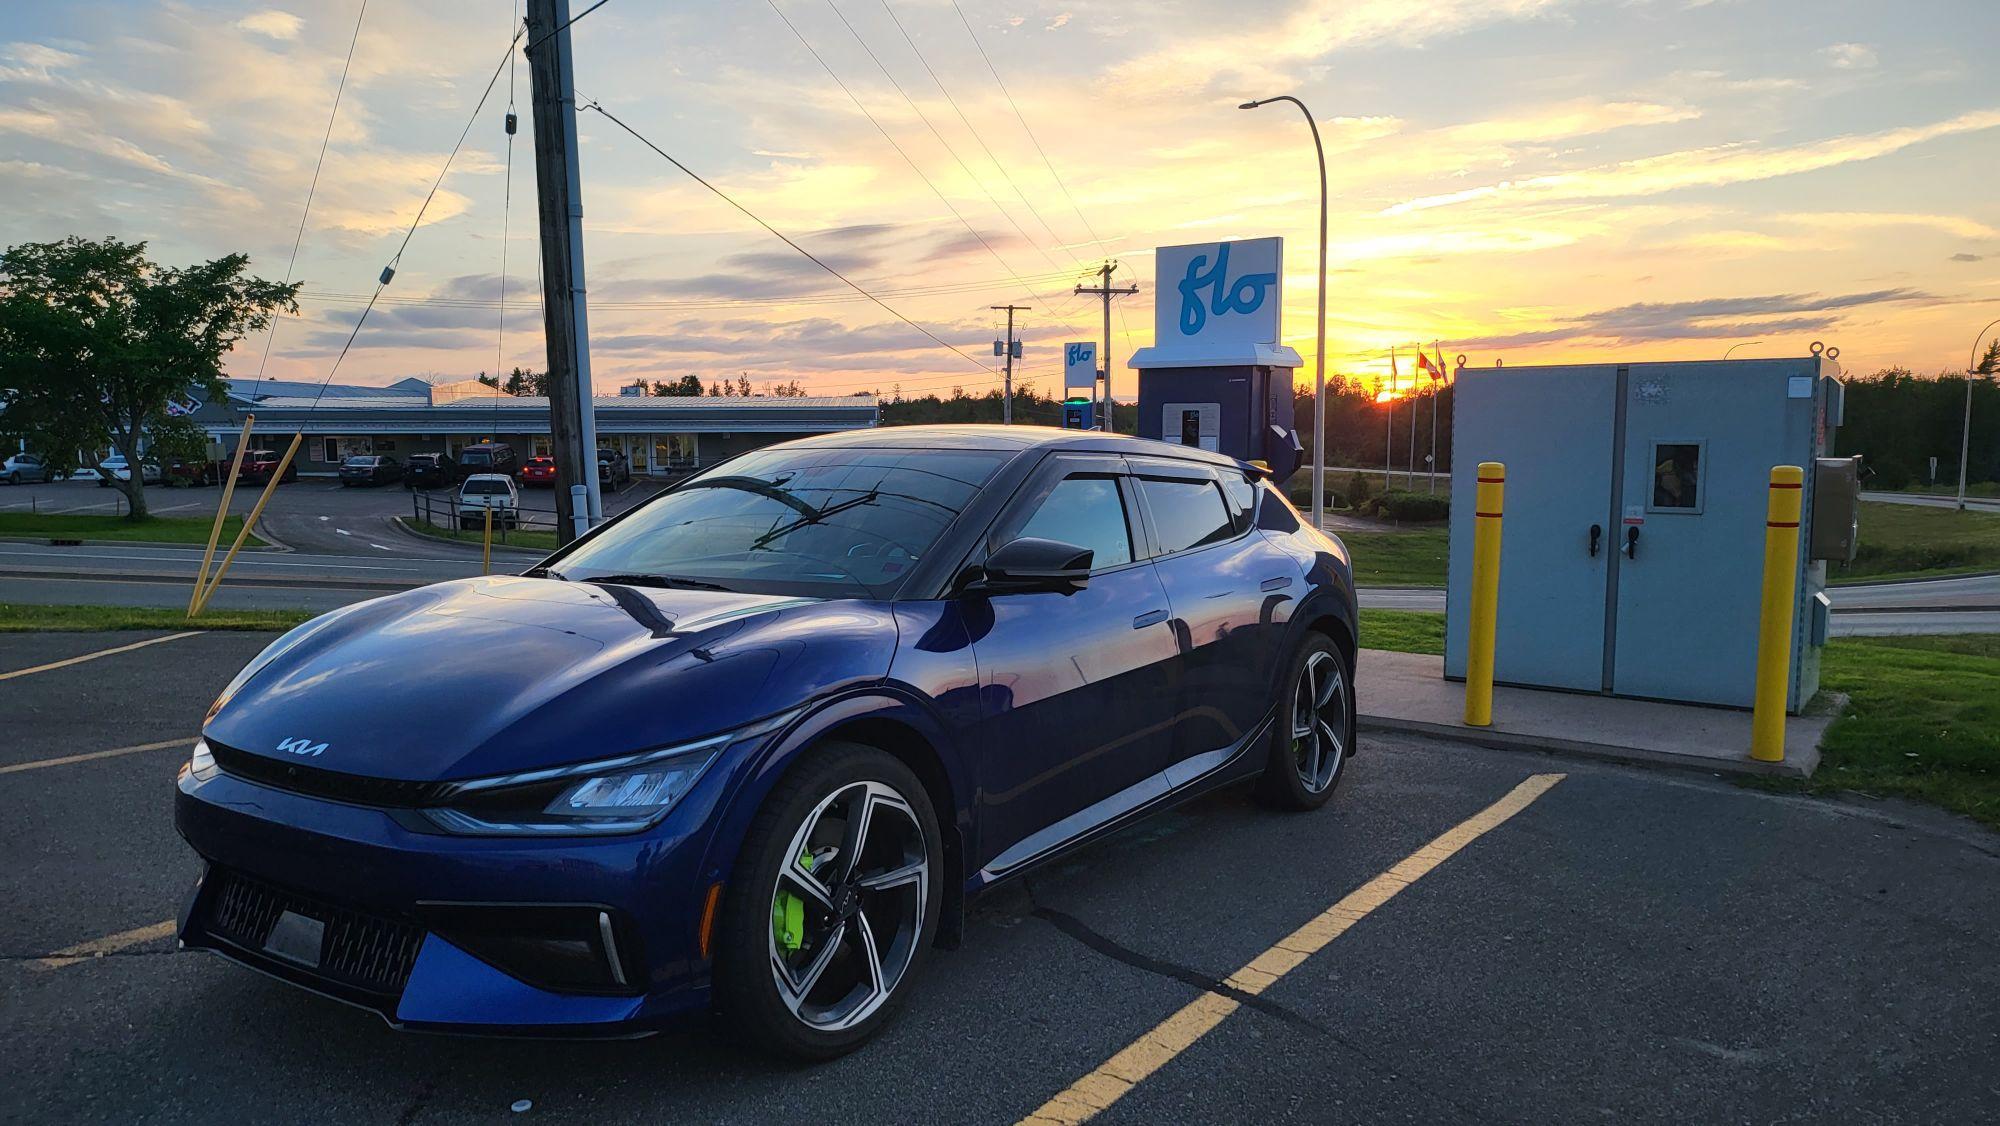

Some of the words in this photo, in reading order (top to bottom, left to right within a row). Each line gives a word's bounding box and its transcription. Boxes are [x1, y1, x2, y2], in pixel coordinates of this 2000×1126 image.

[1178, 242, 1277, 335] flo
[1068, 344, 1092, 366] flo
[276, 737, 329, 756] KIA
